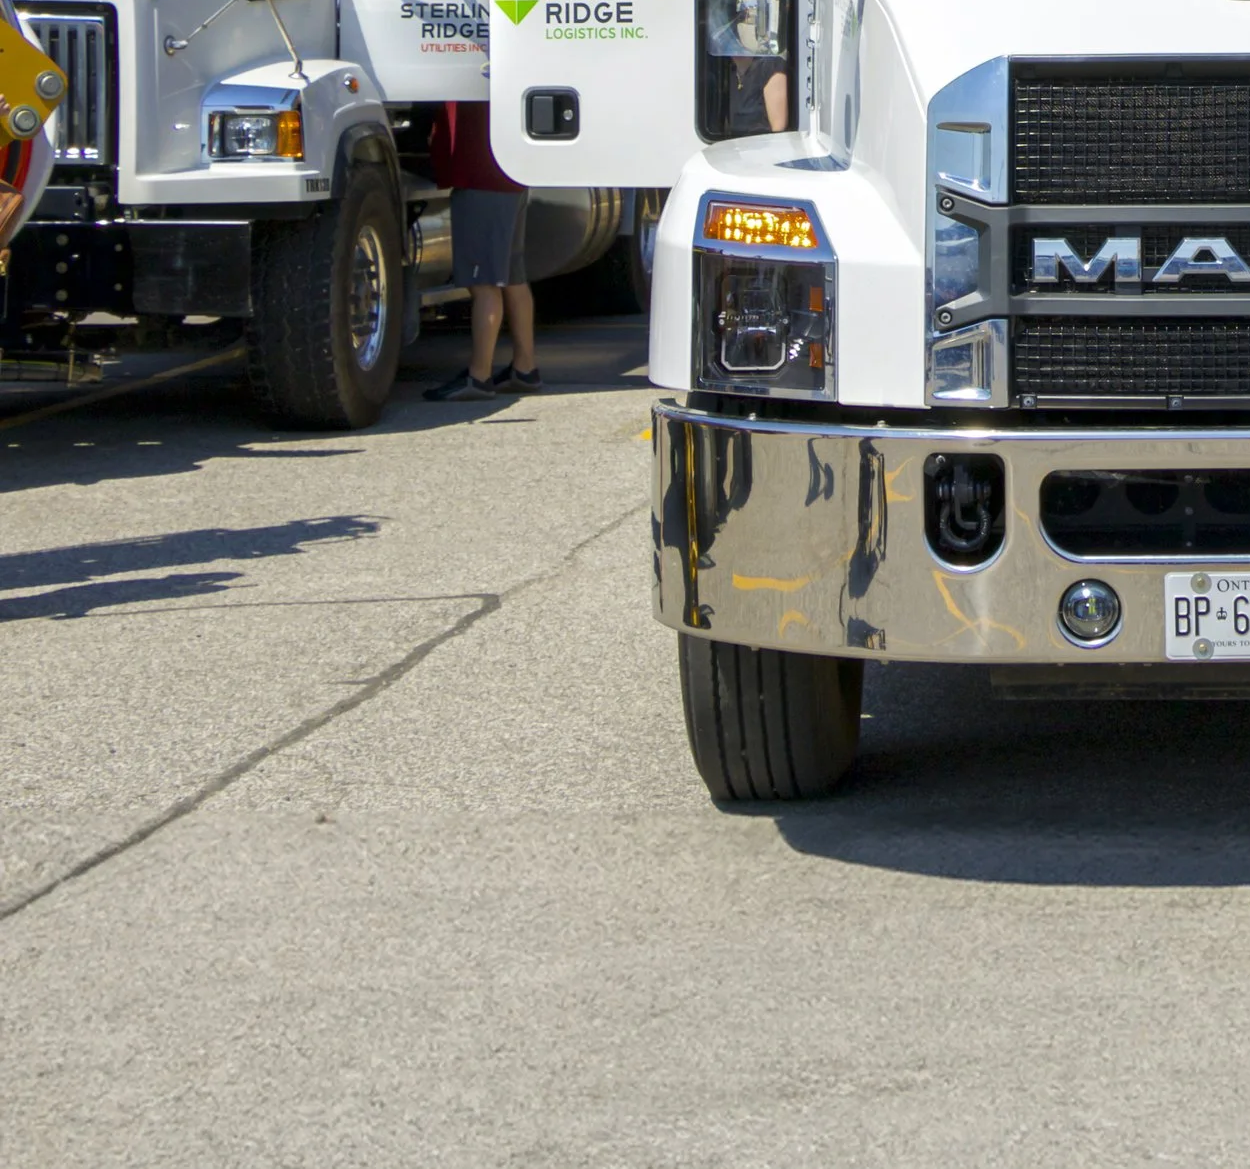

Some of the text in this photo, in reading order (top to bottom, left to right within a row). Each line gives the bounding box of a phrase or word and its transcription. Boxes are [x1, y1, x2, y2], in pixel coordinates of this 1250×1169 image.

[401, 2, 490, 19] STERLIN
[546, 2, 633, 24] RIDGE
[421, 22, 489, 39] RIDGE
[546, 27, 649, 40] LOGISTICS INC.
[421, 43, 467, 53] UTILITIES
[1174, 596, 1211, 637] BP
[1240, 639, 1250, 647] TO
